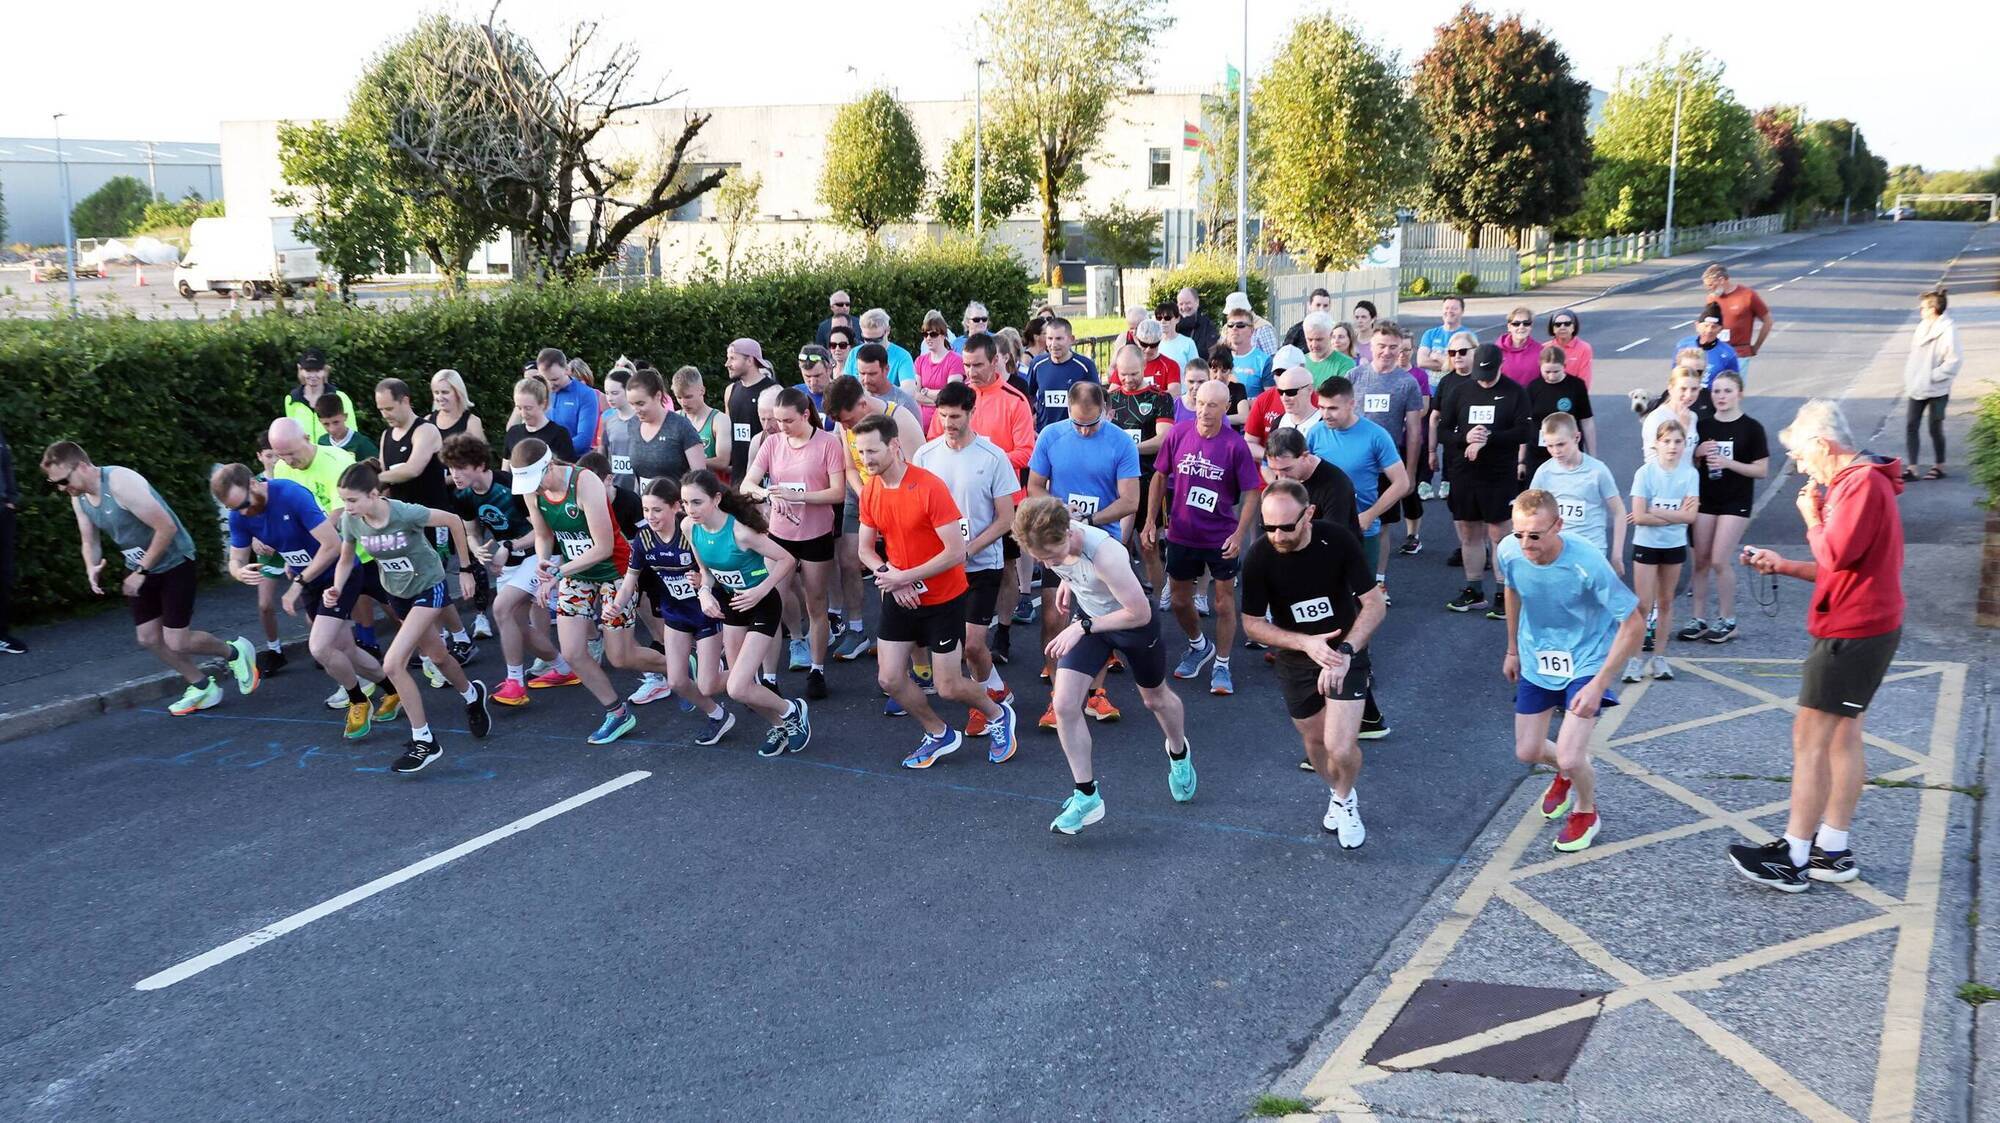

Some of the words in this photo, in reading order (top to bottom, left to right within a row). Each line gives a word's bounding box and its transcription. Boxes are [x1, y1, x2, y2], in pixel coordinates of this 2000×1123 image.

[1046, 394, 1066, 404] 157
[1367, 398, 1387, 409] 179
[735, 427, 750, 438] 151
[613, 459, 632, 470] 200
[1190, 491, 1215, 507] 164
[1558, 504, 1583, 517] 175
[285, 553, 311, 564] 190
[382, 559, 409, 570] 181
[714, 573, 743, 585] 202
[668, 583, 693, 596] 192
[1295, 601, 1329, 618] 189
[1540, 656, 1569, 672] 161
